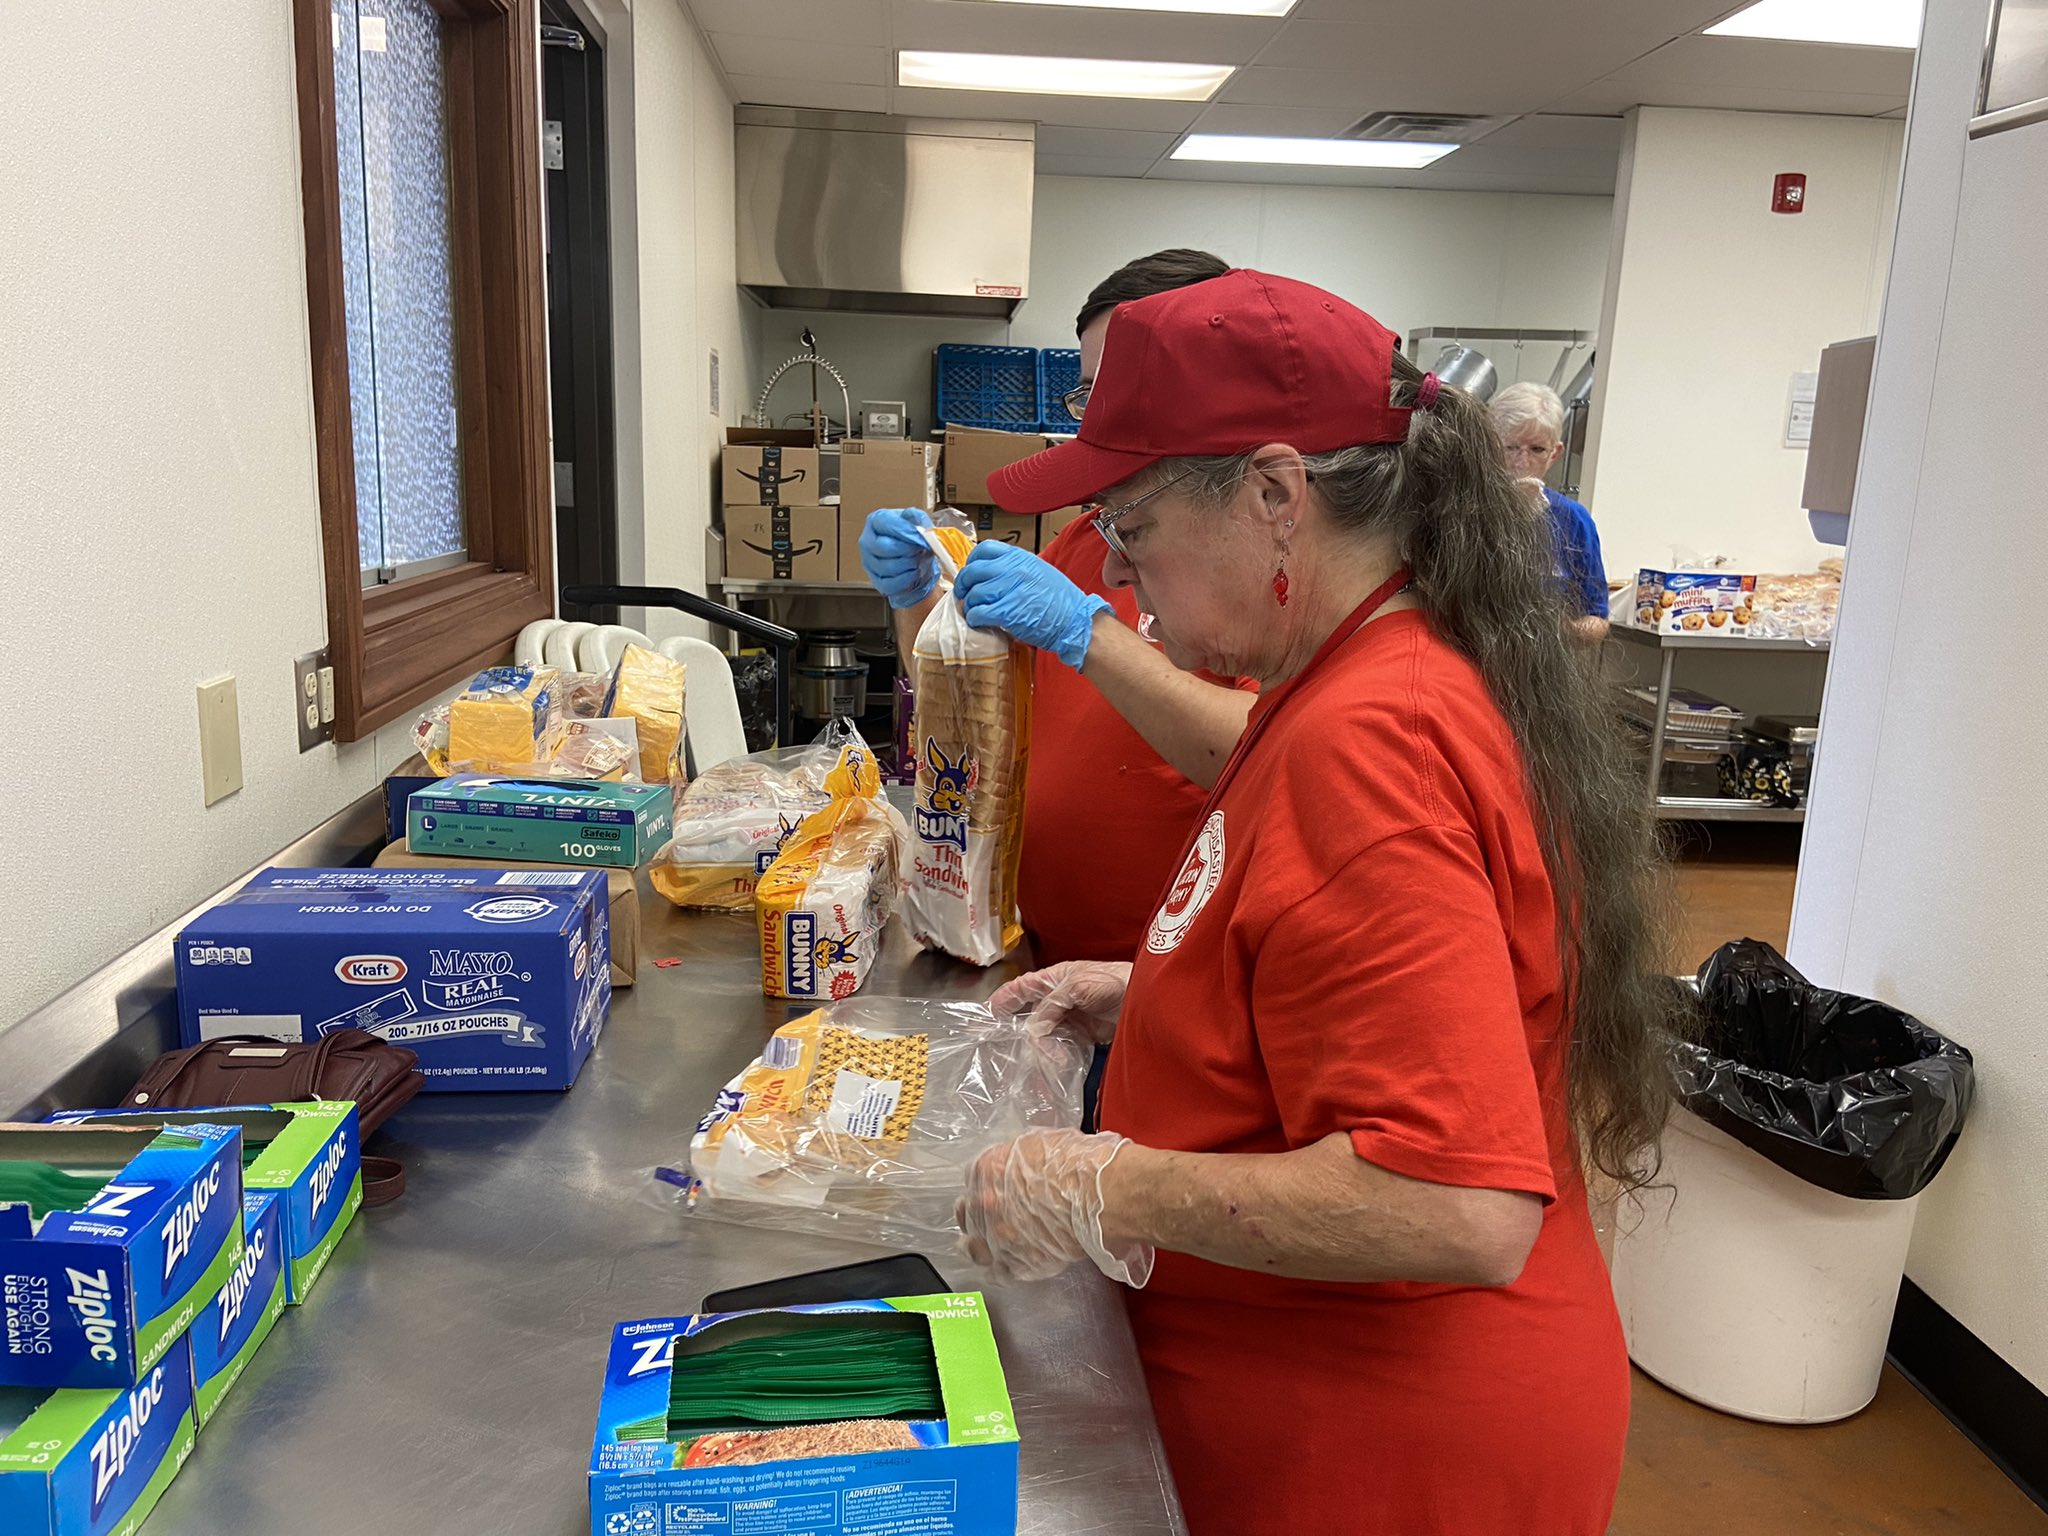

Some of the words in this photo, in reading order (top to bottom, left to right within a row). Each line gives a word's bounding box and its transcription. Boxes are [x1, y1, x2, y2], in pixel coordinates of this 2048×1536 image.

[1674, 596, 1712, 608] muffins
[1681, 587, 1703, 597] mini
[521, 794, 617, 808] VINYL
[424, 818, 433, 829] L
[583, 828, 618, 839] Safeko
[646, 814, 665, 839] VINYL
[752, 824, 779, 839] Original
[918, 814, 962, 841] BUN
[560, 842, 596, 858] 100
[932, 845, 963, 866] Thin
[733, 878, 757, 893] Thi
[298, 905, 360, 913] CRUSH
[833, 904, 851, 935] Original
[429, 950, 513, 976] MAYO
[763, 908, 781, 996] Sandwich
[791, 919, 811, 991] BUNNY
[353, 964, 389, 976] Kraft
[444, 976, 503, 999] REAL
[446, 989, 504, 1007] MAYONNAISE
[388, 1027, 408, 1039] 200
[416, 1023, 439, 1036] 7/16
[442, 1020, 456, 1030] OZ
[459, 1016, 509, 1030] POUCHES
[453, 1067, 478, 1075] POUCHES
[483, 1066, 493, 1074] NET
[494, 1066, 503, 1074] WT
[517, 1066, 524, 1074] LB
[318, 1103, 345, 1111] 145
[309, 1131, 346, 1220] Ziploc
[161, 1161, 220, 1280] Ziploc
[228, 1241, 242, 1268] 145
[302, 1241, 331, 1295] SANDWICH
[4, 1274, 18, 1304] USE
[218, 1228, 264, 1342] Ziploc
[17, 1275, 32, 1333] ENOUGH
[271, 1297, 283, 1322] 145
[944, 1296, 977, 1308] 145
[30, 1276, 52, 1355] STRONG
[65, 1267, 117, 1361] Ziploc
[5, 1307, 22, 1354] AGAIN
[141, 1302, 194, 1371] SANDWICH
[22, 1337, 34, 1354] TO
[90, 1367, 163, 1505] Ziploc
[175, 1437, 192, 1469] 145
[644, 1451, 653, 1459] IN
[626, 1482, 642, 1490] brand
[643, 1481, 657, 1489] bags
[667, 1479, 691, 1487] reusable
[692, 1478, 705, 1486] after
[745, 1475, 755, 1483] and
[786, 1470, 793, 1478] do
[794, 1469, 803, 1477] not
[803, 1467, 836, 1476] recommend
[836, 1465, 856, 1473] reusing
[626, 1490, 642, 1498] brand
[643, 1489, 657, 1497] bags
[658, 1488, 671, 1496] after
[671, 1487, 692, 1496] storing
[784, 1478, 802, 1488] allergy
[803, 1476, 829, 1487] triggering
[846, 1484, 903, 1500] ¡ADVERTENCIA!
[734, 1499, 777, 1511] WARNING!
